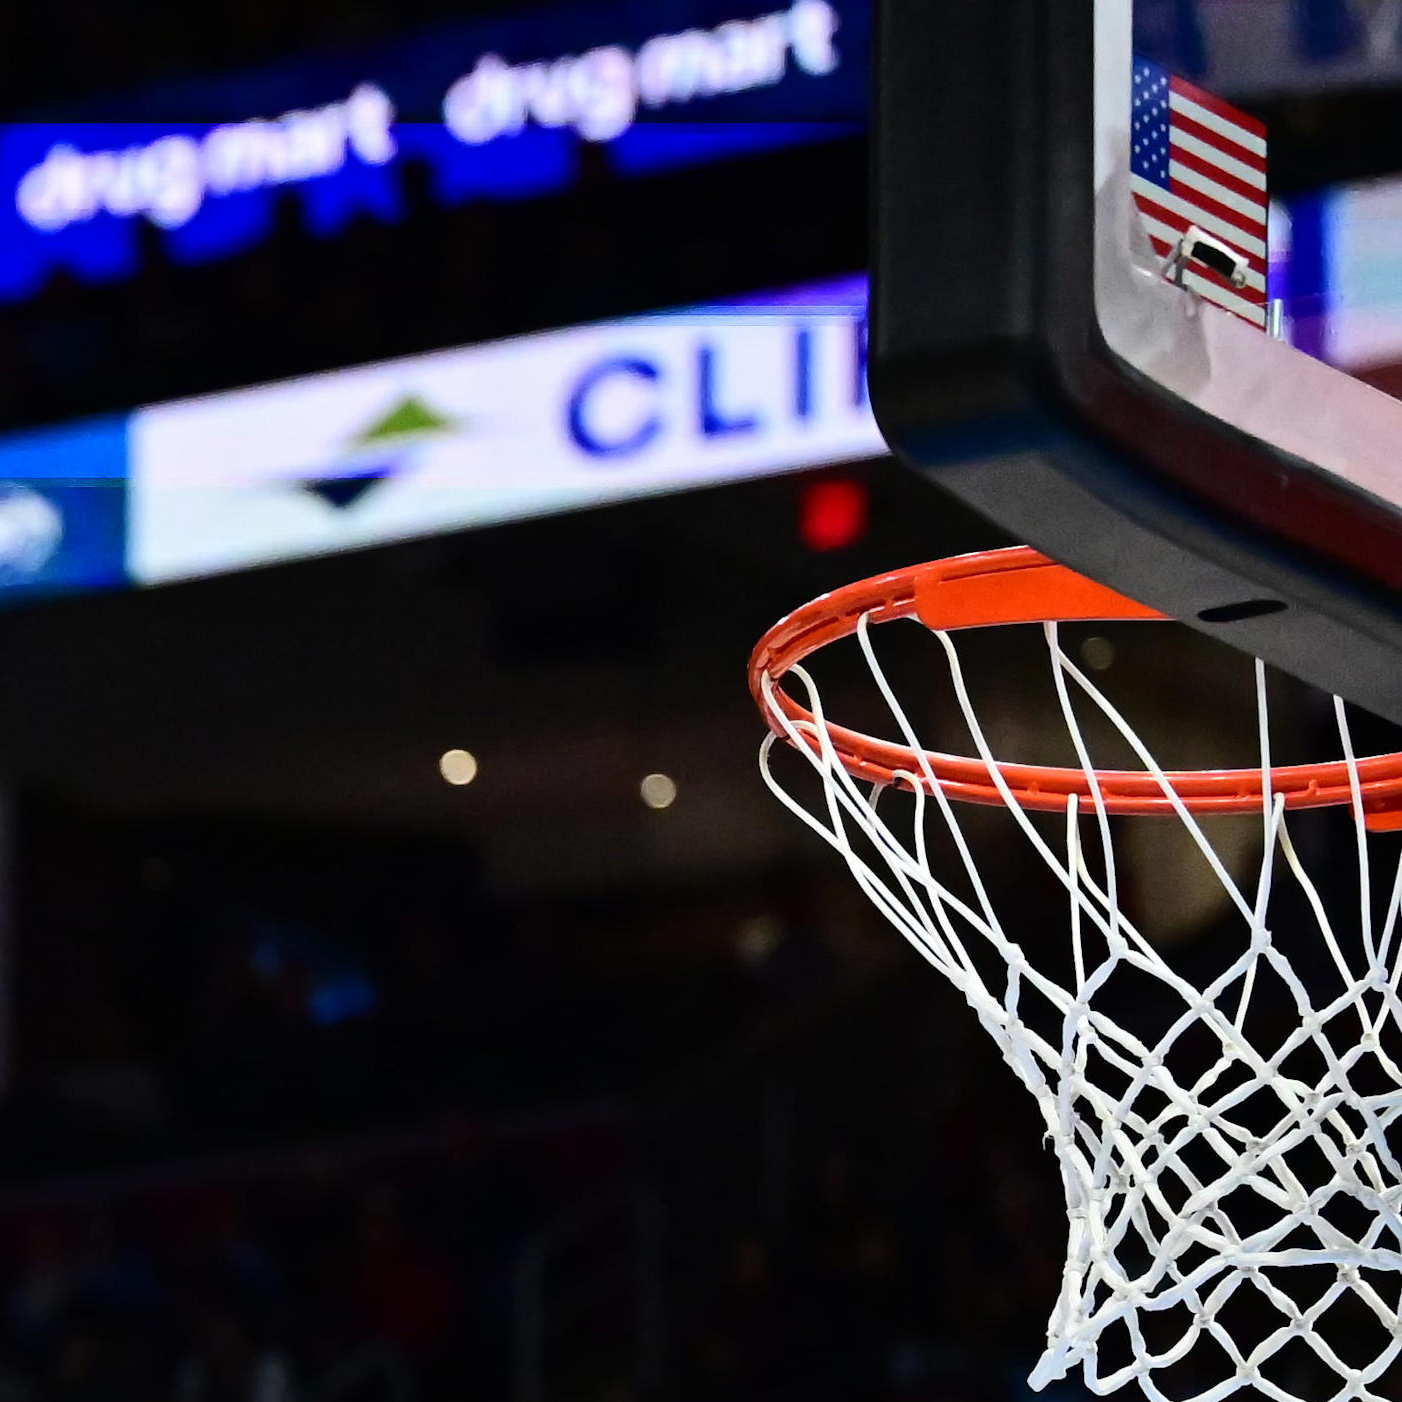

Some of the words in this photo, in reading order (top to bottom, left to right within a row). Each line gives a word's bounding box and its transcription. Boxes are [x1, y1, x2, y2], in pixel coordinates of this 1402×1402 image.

[444, 50, 637, 146] drug
[637, 0, 838, 106] mart
[16, 143, 201, 232] drug
[198, 82, 394, 194] mart
